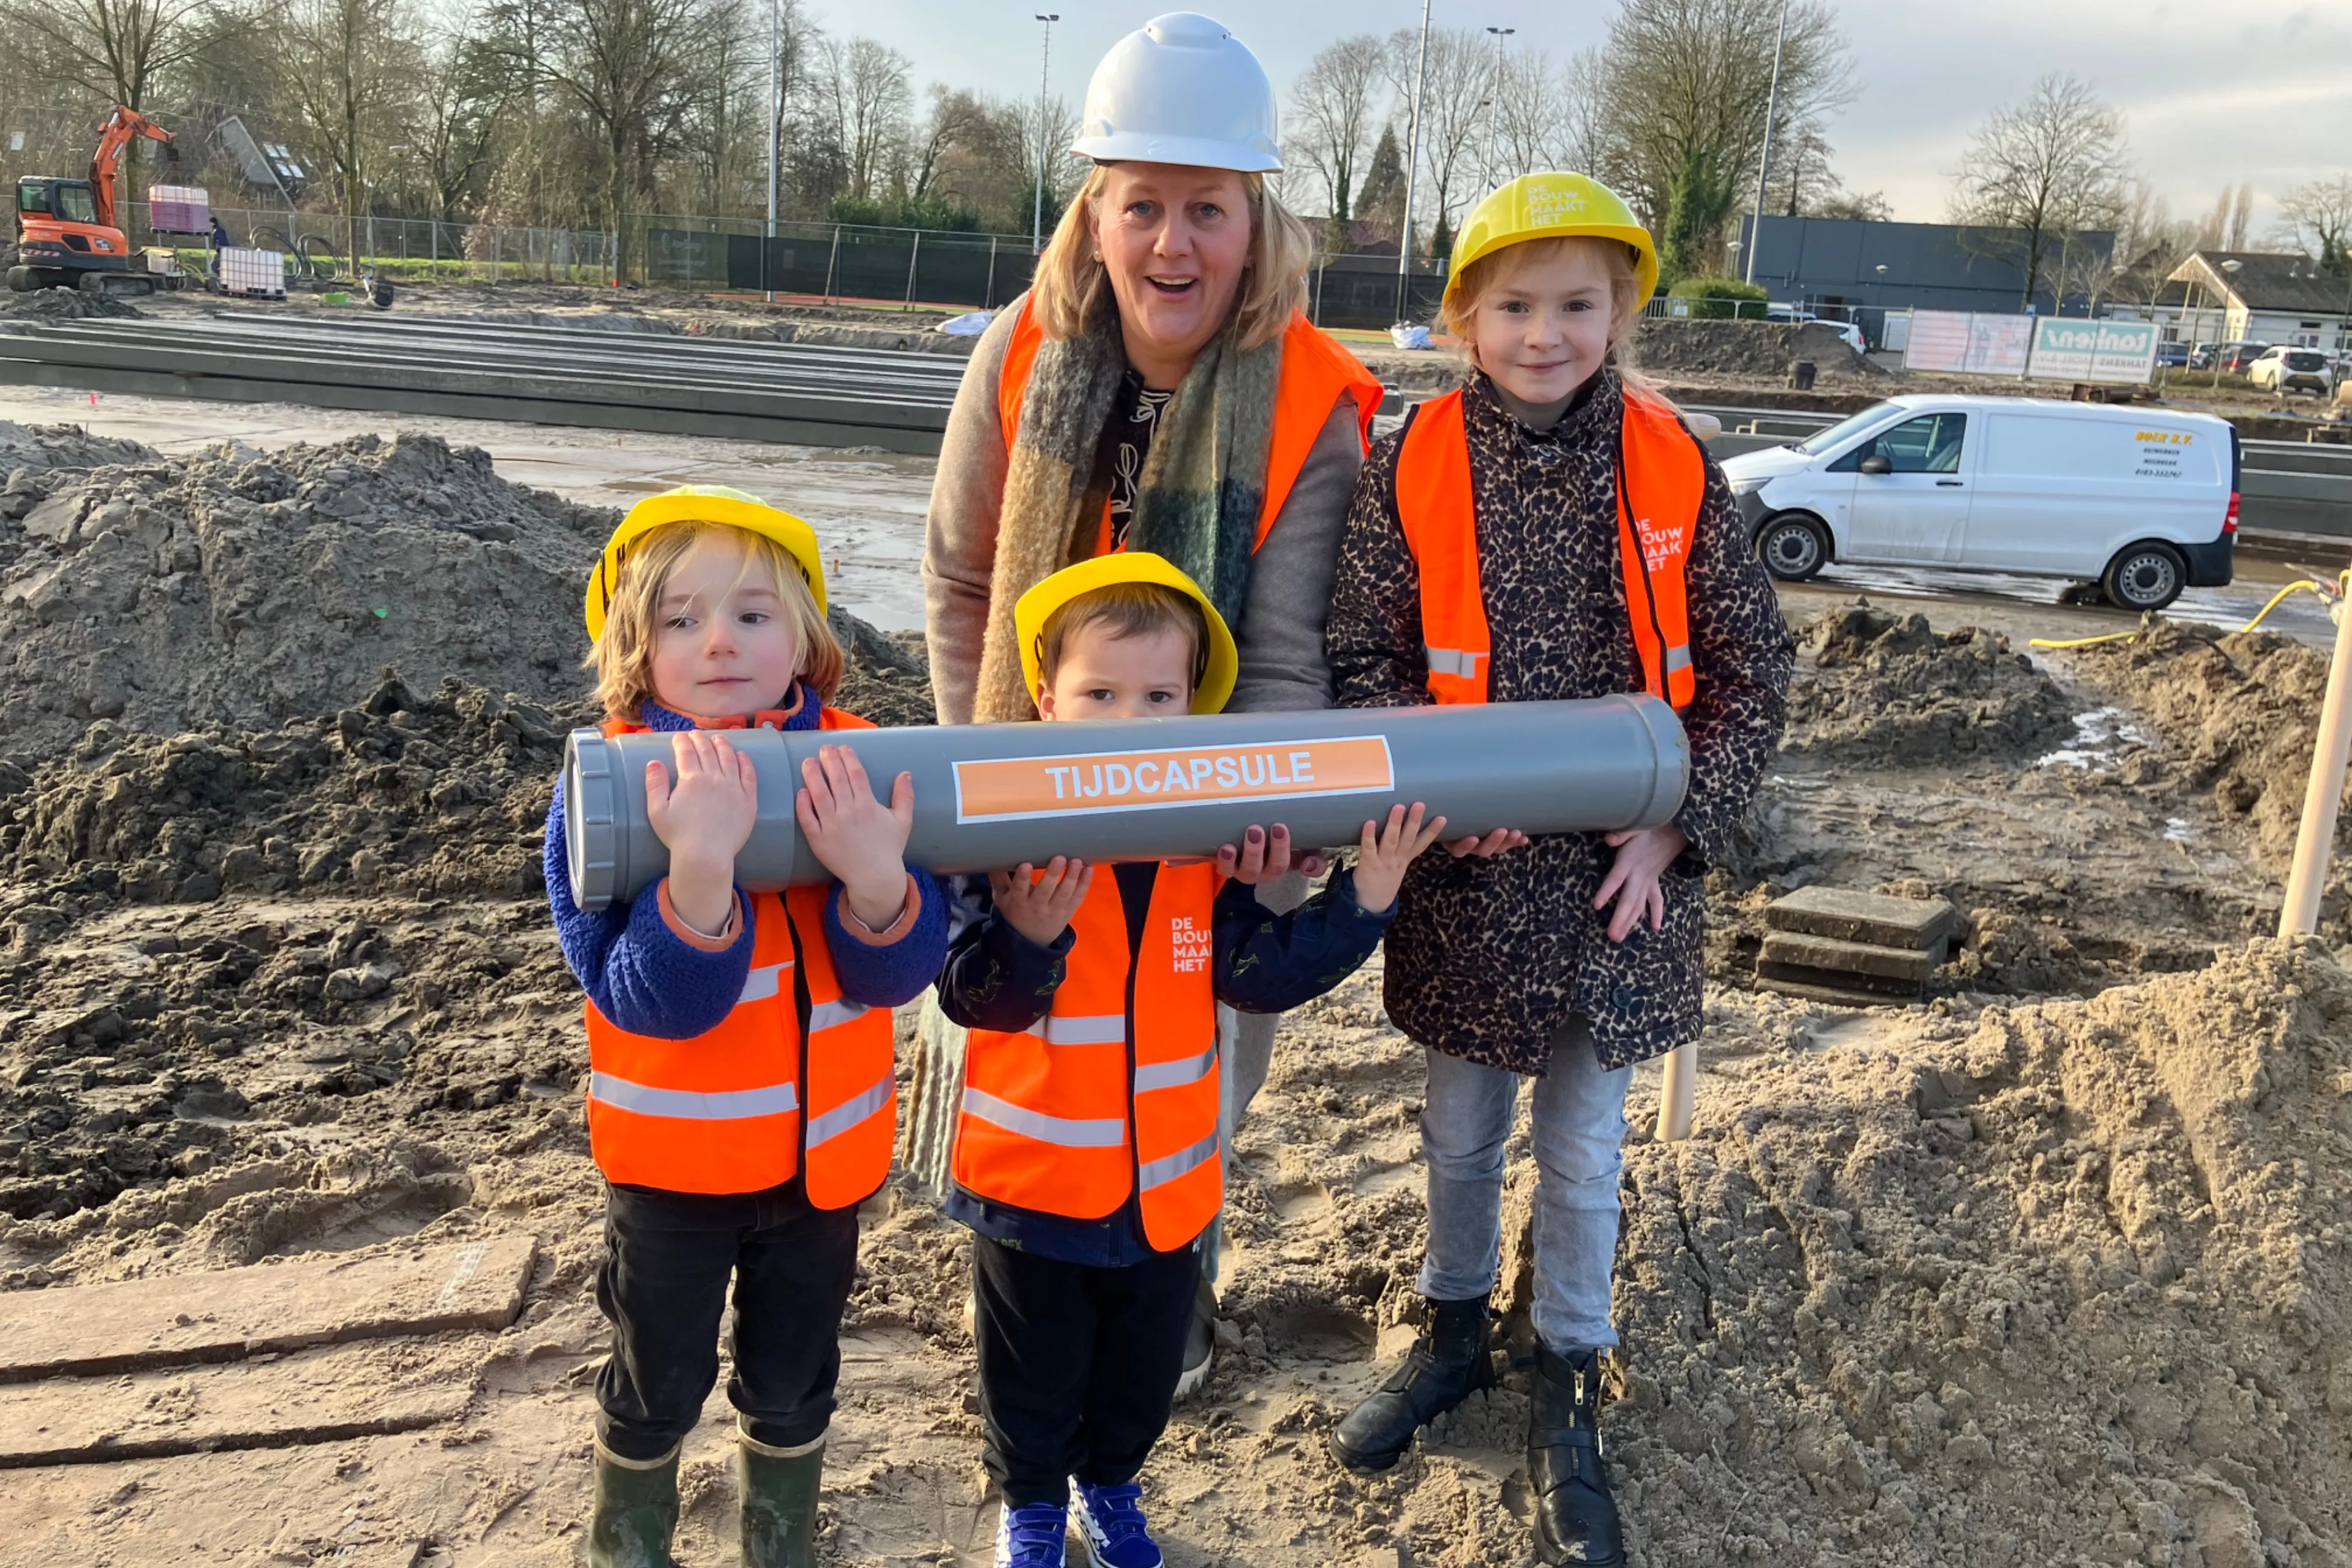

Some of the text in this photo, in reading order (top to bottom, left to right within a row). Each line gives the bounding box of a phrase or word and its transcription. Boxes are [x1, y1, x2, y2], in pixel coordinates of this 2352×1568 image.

[1528, 185, 1546, 194] DE
[1529, 191, 1578, 203] BOUW
[1531, 201, 1585, 215] MAAKT
[1532, 213, 1561, 227] HET
[1642, 527, 1683, 545] OUW
[1648, 557, 1666, 572] ET
[1045, 752, 1314, 799] TIJDCAPSULE
[1171, 917, 1193, 930] DE
[1174, 959, 1205, 972] HET
